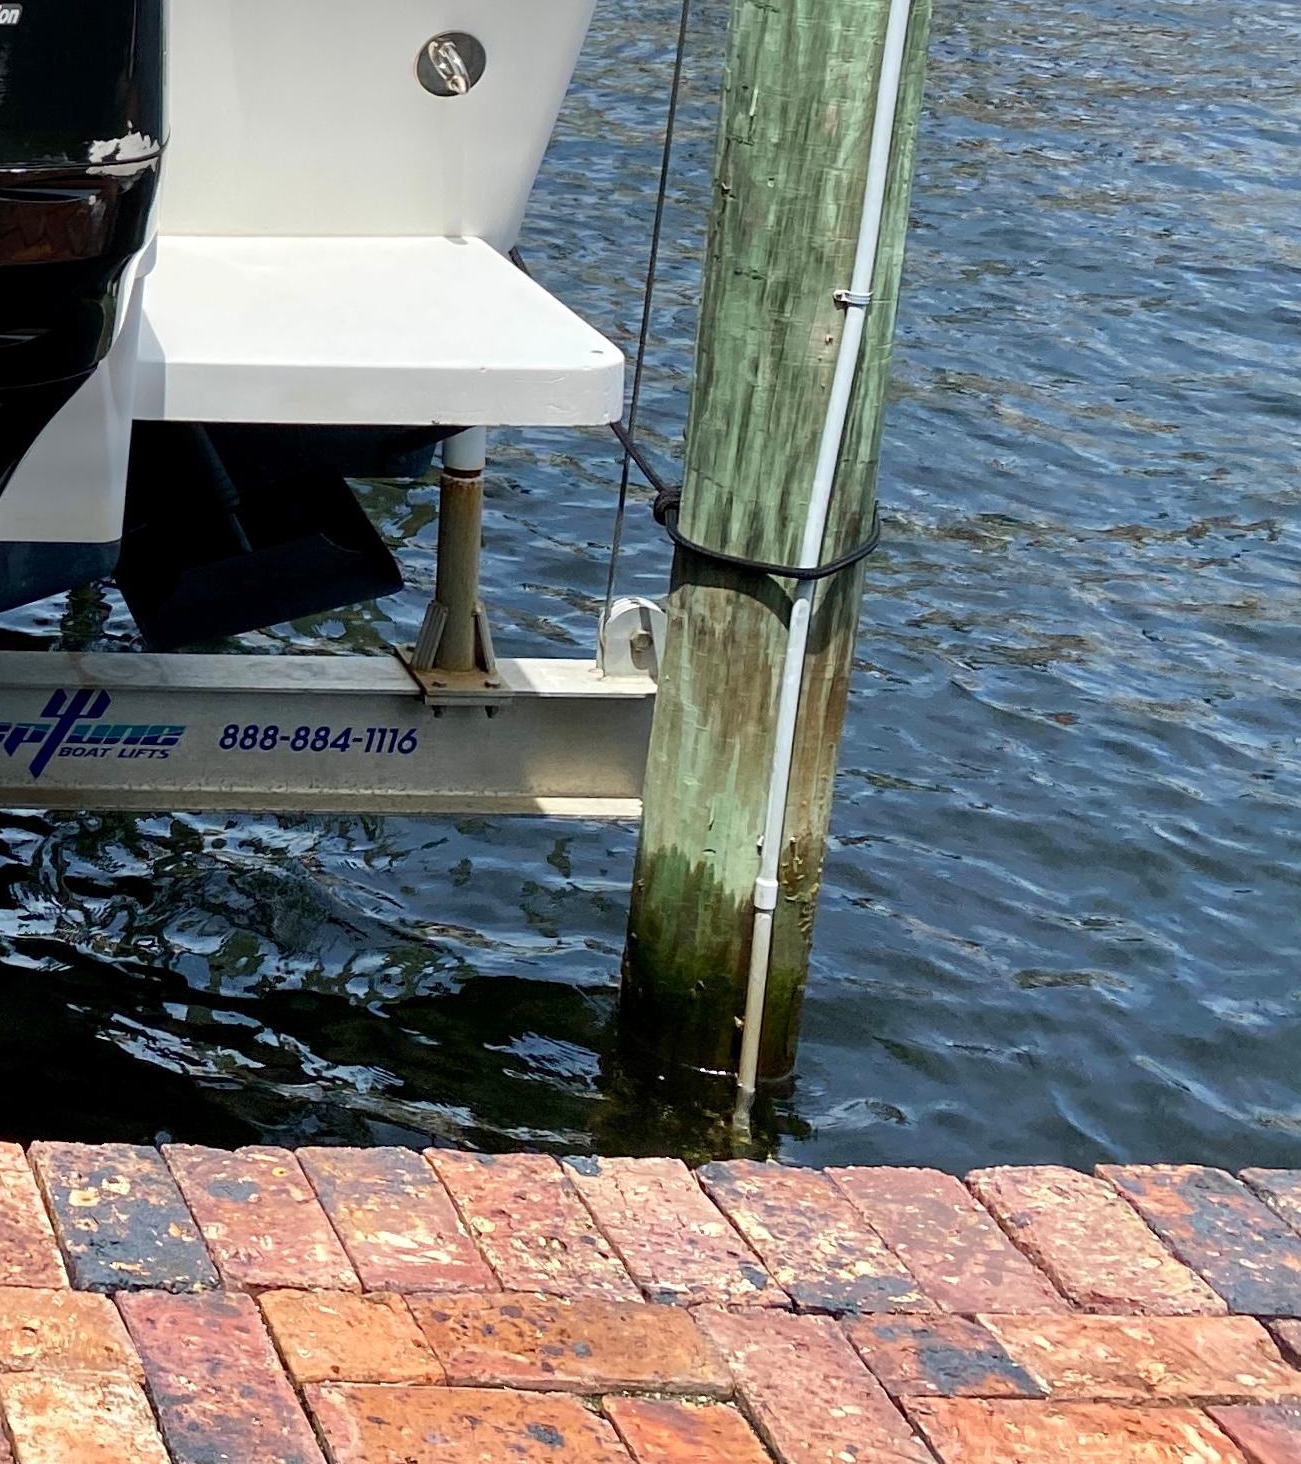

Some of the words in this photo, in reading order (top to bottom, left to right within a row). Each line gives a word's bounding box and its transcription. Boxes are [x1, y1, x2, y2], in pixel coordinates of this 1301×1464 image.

[218, 723, 418, 755] 888-884-1116
[57, 747, 112, 759] BOAT
[117, 747, 170, 759] LIFTS
